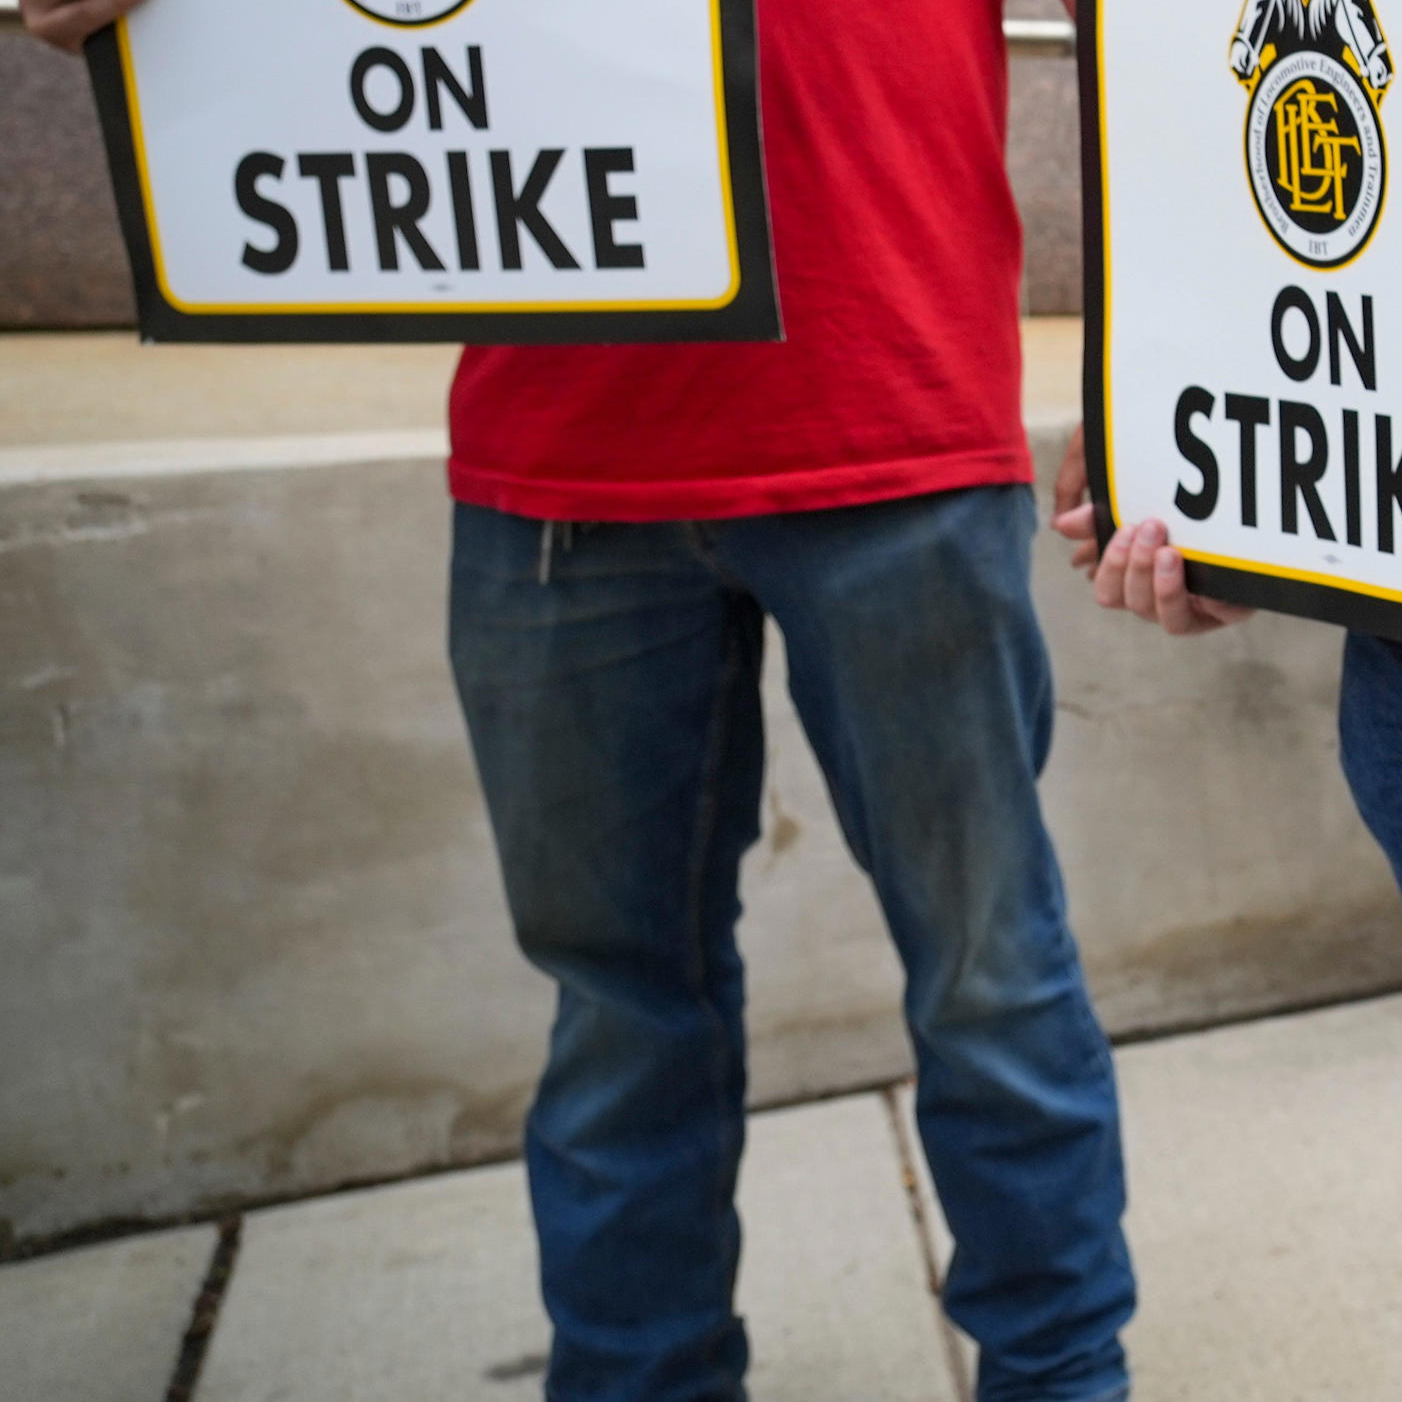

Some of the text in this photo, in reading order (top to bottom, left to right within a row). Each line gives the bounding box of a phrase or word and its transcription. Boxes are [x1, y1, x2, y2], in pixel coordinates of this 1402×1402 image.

[349, 45, 489, 133] ON
[234, 147, 645, 275] STRIKE
[1270, 285, 1377, 391] ON
